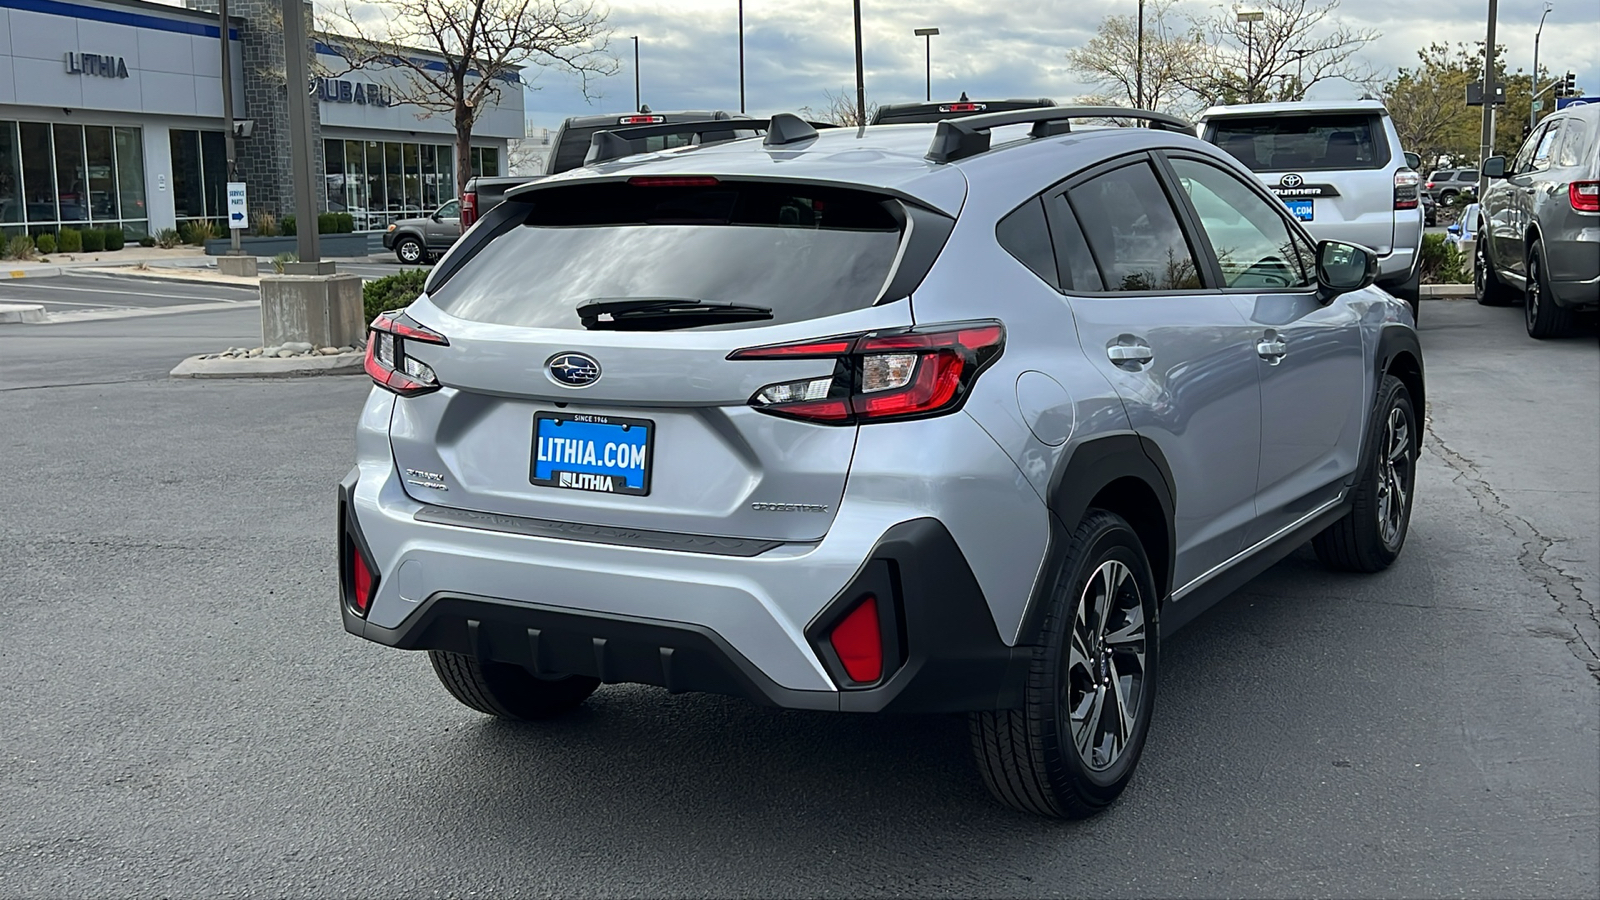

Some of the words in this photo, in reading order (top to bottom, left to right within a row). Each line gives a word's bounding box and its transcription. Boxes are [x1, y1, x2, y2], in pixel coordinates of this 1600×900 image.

[65, 51, 129, 79] LITHIA
[317, 76, 391, 107] SUBARU
[574, 414, 593, 423] SINCE
[594, 416, 608, 424] 1946
[537, 436, 646, 470] LITHIA.COM
[571, 472, 614, 492] LITHIA
[751, 501, 829, 513] CROSSTREK
